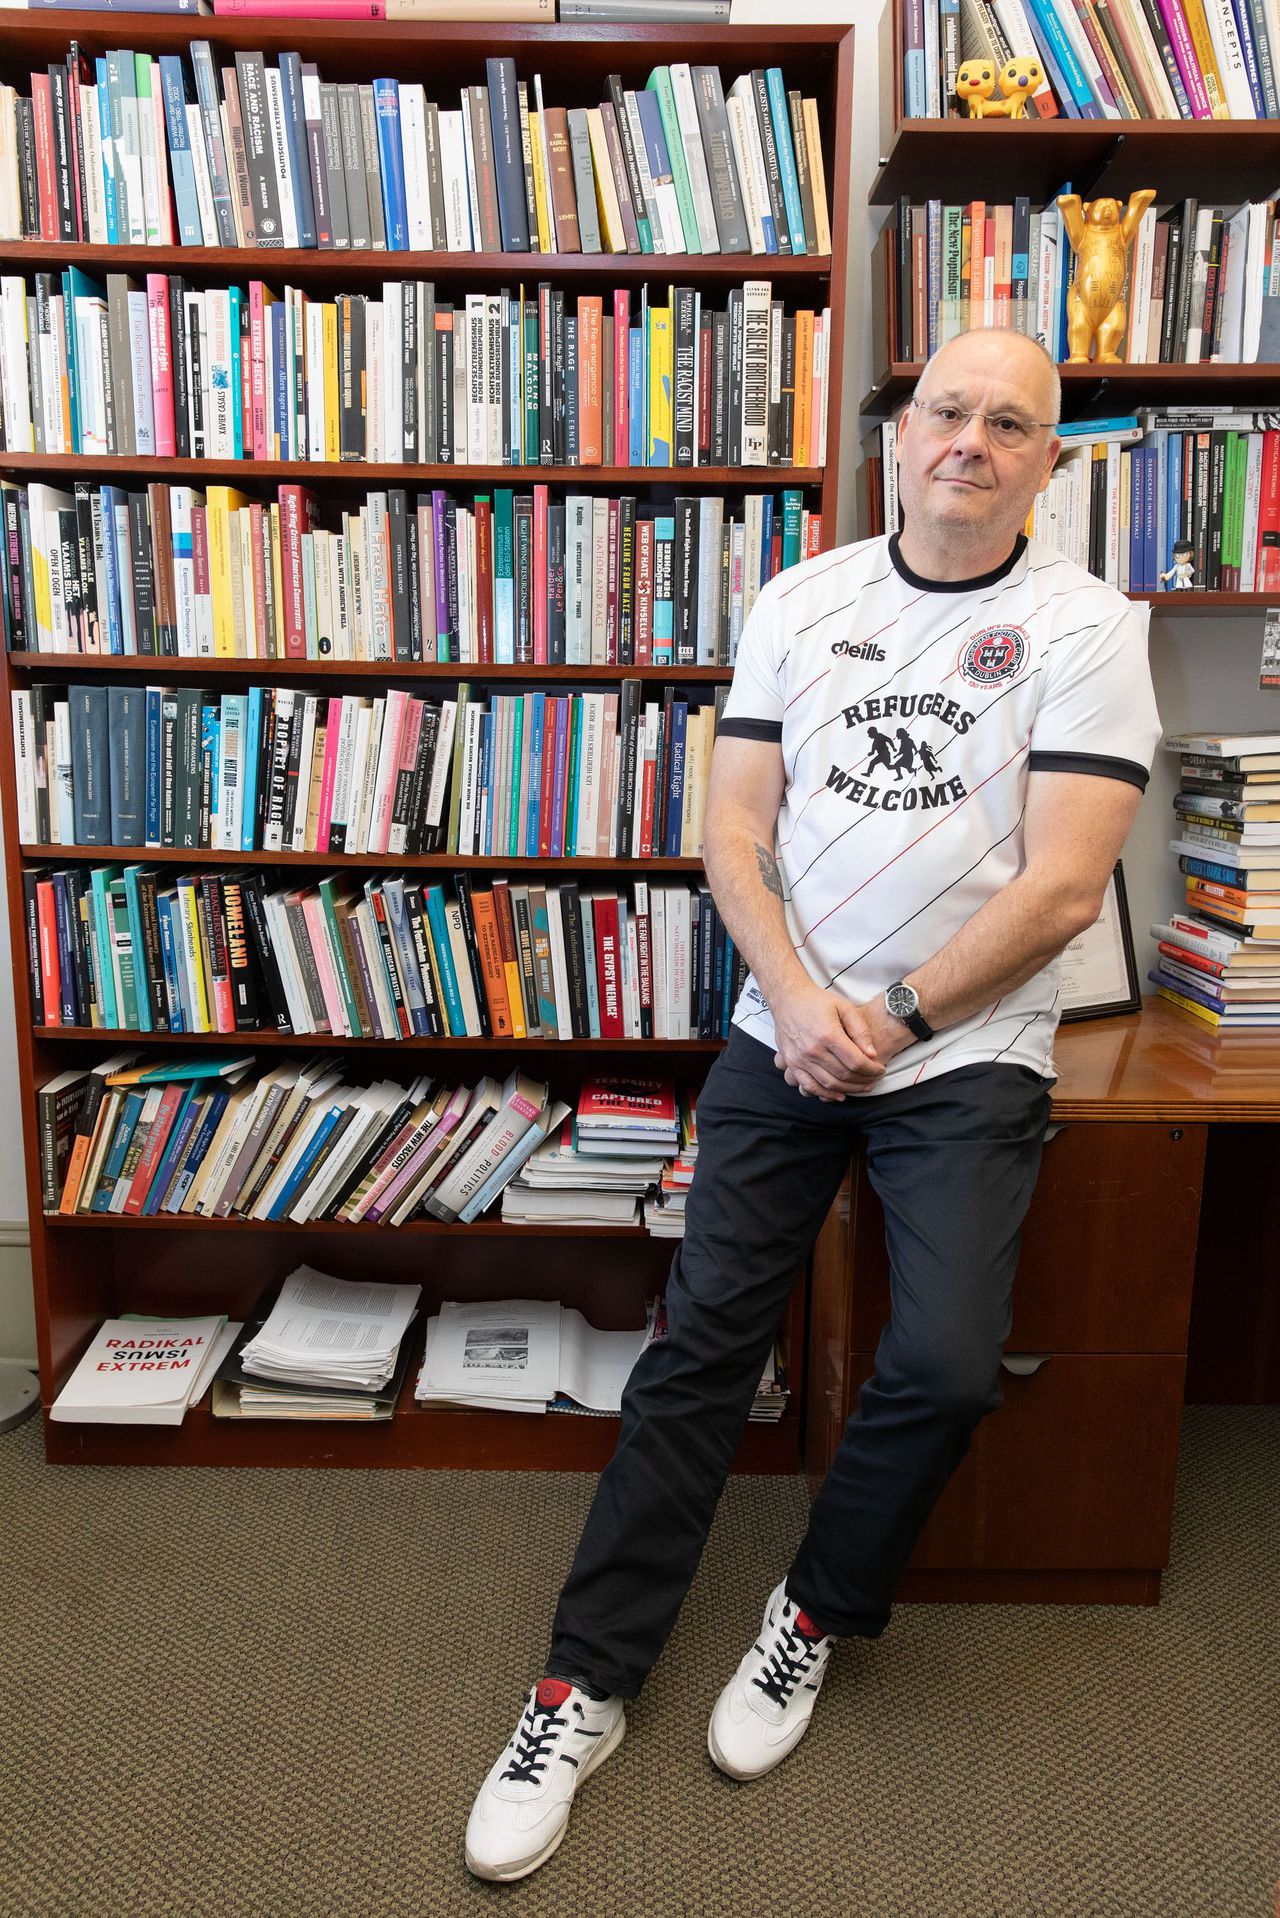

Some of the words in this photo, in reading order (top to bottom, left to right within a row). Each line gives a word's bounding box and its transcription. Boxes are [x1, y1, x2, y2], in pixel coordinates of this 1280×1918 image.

[245, 63, 257, 90] RACE
[1186, 49, 1200, 83] POLITICAL
[1196, 81, 1208, 109] SCIENCE
[248, 92, 259, 113] AND
[270, 74, 283, 130] EXTREMISMUS
[518, 89, 529, 107] THE
[520, 107, 530, 129] NEW
[618, 107, 629, 131] Illiberal
[757, 78, 769, 113] FASCISTS
[763, 125, 780, 181] CONSERVATIVES
[249, 115, 264, 155] RACISM
[621, 132, 632, 155] Politics
[232, 126, 247, 174] Right-Wing
[277, 130, 287, 179] POLITISCHER
[521, 130, 533, 165] RACISM
[628, 161, 640, 194] Neoliberal
[239, 174, 250, 208] Women
[635, 194, 644, 214] Times
[948, 210, 959, 229] The
[948, 229, 959, 250] New
[946, 250, 960, 296] Populism
[471, 301, 484, 309] 1
[488, 302, 500, 315] 2
[746, 309, 769, 326] THE
[252, 319, 262, 359] EXTREEM
[567, 320, 575, 341] THE
[745, 327, 768, 361] SILENT
[471, 317, 479, 404] RECHTSEXTREMISMUS
[488, 318, 496, 405] RECHTSEXTREMISMUS
[677, 346, 693, 368] THE
[253, 362, 264, 395] RECHTS
[279, 369, 287, 392] Alleen
[677, 370, 693, 403] RACIST
[278, 392, 287, 410] tegen
[478, 396, 483, 404] IN
[495, 396, 501, 405] IN
[744, 362, 767, 427] BROTHERHOOD
[280, 410, 288, 419] de
[677, 404, 693, 432] MIND
[280, 419, 289, 443] wereld
[568, 419, 576, 449] EBNER
[7, 502, 18, 531] AMERICAN
[288, 494, 299, 530] Right-Wing
[1147, 503, 1153, 511] IN
[289, 529, 300, 551] Critics
[623, 527, 631, 563] HEALING
[641, 525, 649, 545] WEB
[9, 531, 20, 566] EXTREMISTS
[50, 549, 60, 568] OPEN
[61, 540, 72, 579] VLAAMS
[291, 551, 300, 559] of
[370, 531, 385, 577] Free
[595, 536, 604, 575] NATION
[641, 545, 649, 557] OF
[51, 568, 60, 577] JE
[291, 559, 302, 588] American
[623, 566, 631, 589] FROM
[640, 557, 649, 578] HATE
[52, 577, 61, 596] OGEN
[64, 579, 73, 603] BLOK
[71, 579, 81, 599] HET
[595, 579, 604, 600] AND
[292, 588, 303, 631] Conservatism
[373, 588, 389, 636] Hate
[622, 593, 631, 614] HATE
[595, 604, 604, 629] RACE
[639, 596, 648, 639] KINSELLA
[974, 670, 1002, 679] DUBLIN
[979, 681, 1003, 690] YEARS
[840, 692, 978, 736] REFUGEES
[275, 715, 290, 771] PROPHET
[673, 742, 684, 775] Radical
[149, 770, 157, 798] European
[273, 775, 285, 790] OF
[671, 775, 682, 800] Right
[825, 764, 969, 812] WELCOME
[270, 795, 283, 826] RAGE
[182, 893, 191, 920] Literary
[204, 898, 212, 912] RISE
[209, 883, 223, 933] PREACHERS
[206, 913, 213, 922] OF
[223, 884, 248, 969] HOMELAND
[451, 910, 462, 930] NPD
[638, 918, 648, 930] THE
[185, 921, 197, 963] Skinheads?
[215, 934, 223, 946] OF
[603, 935, 614, 951] THE
[639, 929, 648, 943] FAR
[210, 950, 218, 971] RIGHT
[216, 947, 226, 971] HATE
[383, 943, 396, 972] AMERICAN
[639, 942, 648, 959] RIGHT
[604, 953, 615, 981] GYPSY
[640, 966, 649, 977] THE
[389, 972, 401, 1002] SWASTIKA
[641, 977, 650, 1005] BALKANS
[591, 1093, 663, 1106] CAPTURED
[420, 1119, 433, 1132] THE
[409, 1131, 425, 1146] NEW
[490, 1129, 514, 1157] BLOOD
[392, 1144, 413, 1169] FASCISTS
[459, 1158, 492, 1197] POLITICS
[104, 1336, 205, 1350] RADIKAL
[95, 1359, 192, 1372] EXTREM
